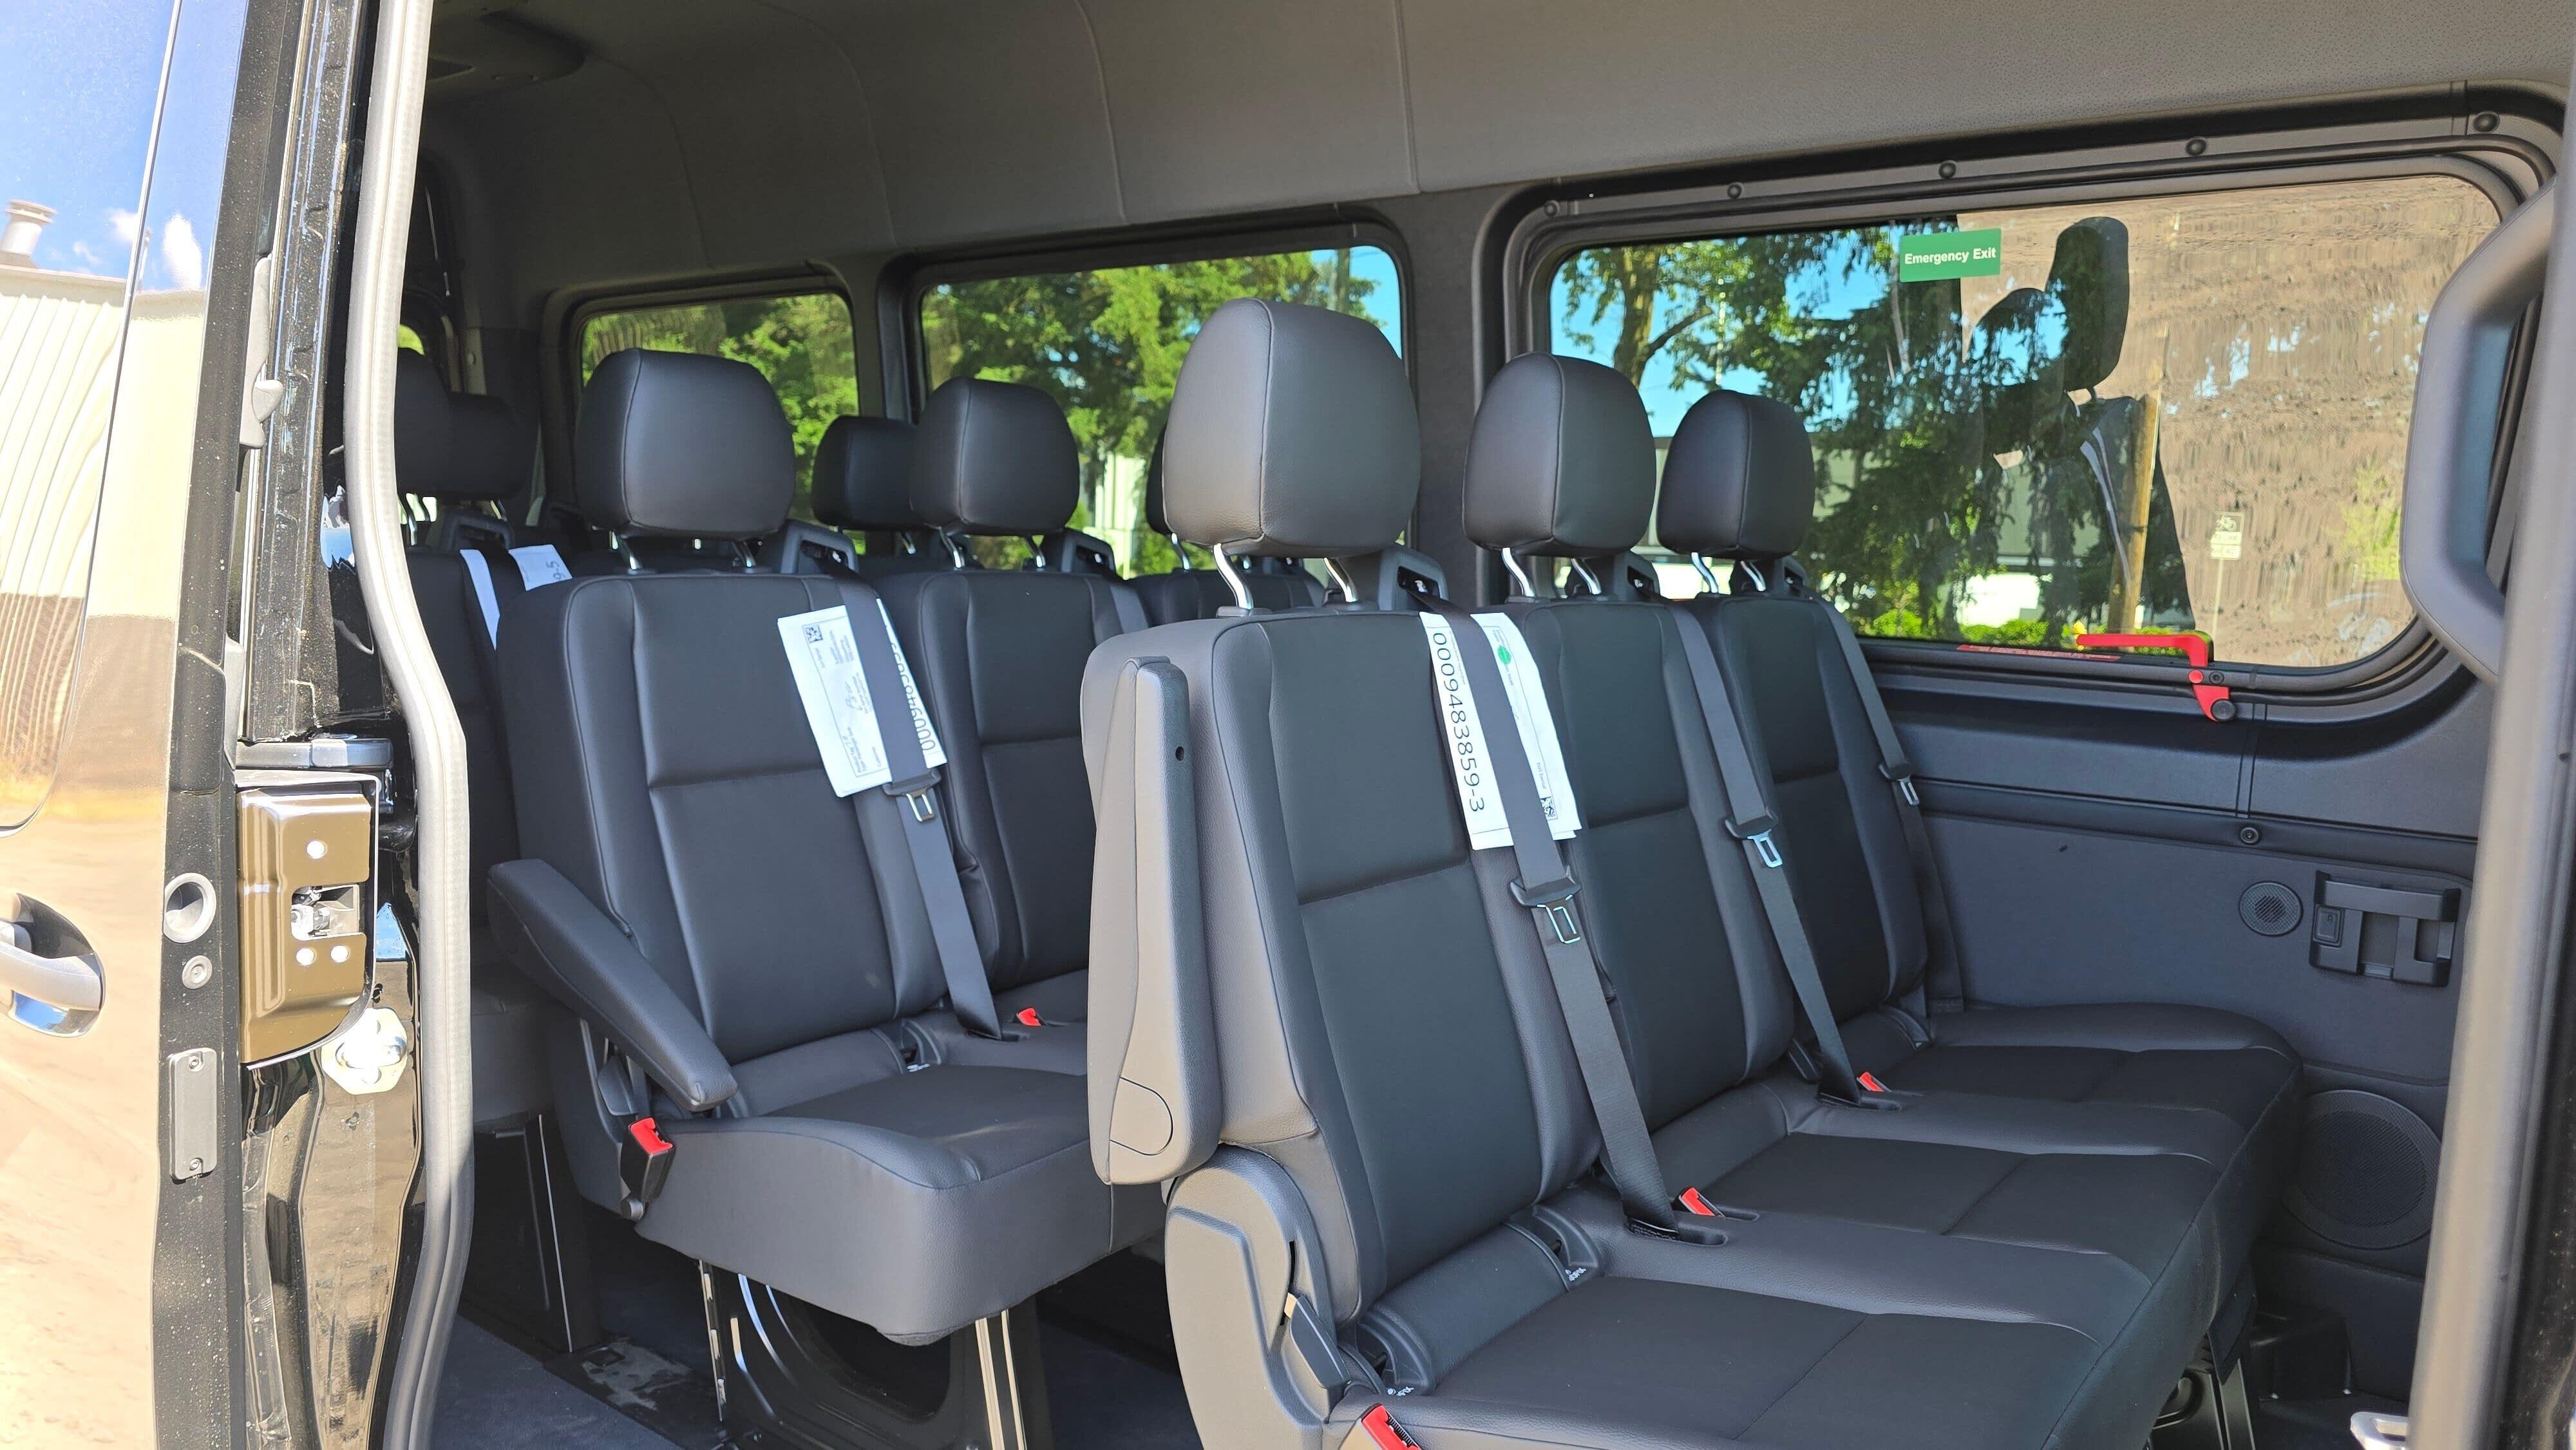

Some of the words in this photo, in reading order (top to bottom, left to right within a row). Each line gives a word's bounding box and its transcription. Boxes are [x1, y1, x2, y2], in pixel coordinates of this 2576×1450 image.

[1904, 250, 1969, 265] Emergency
[1973, 247, 1996, 259] Exit
[1432, 632, 1484, 812] 0009483859-3
